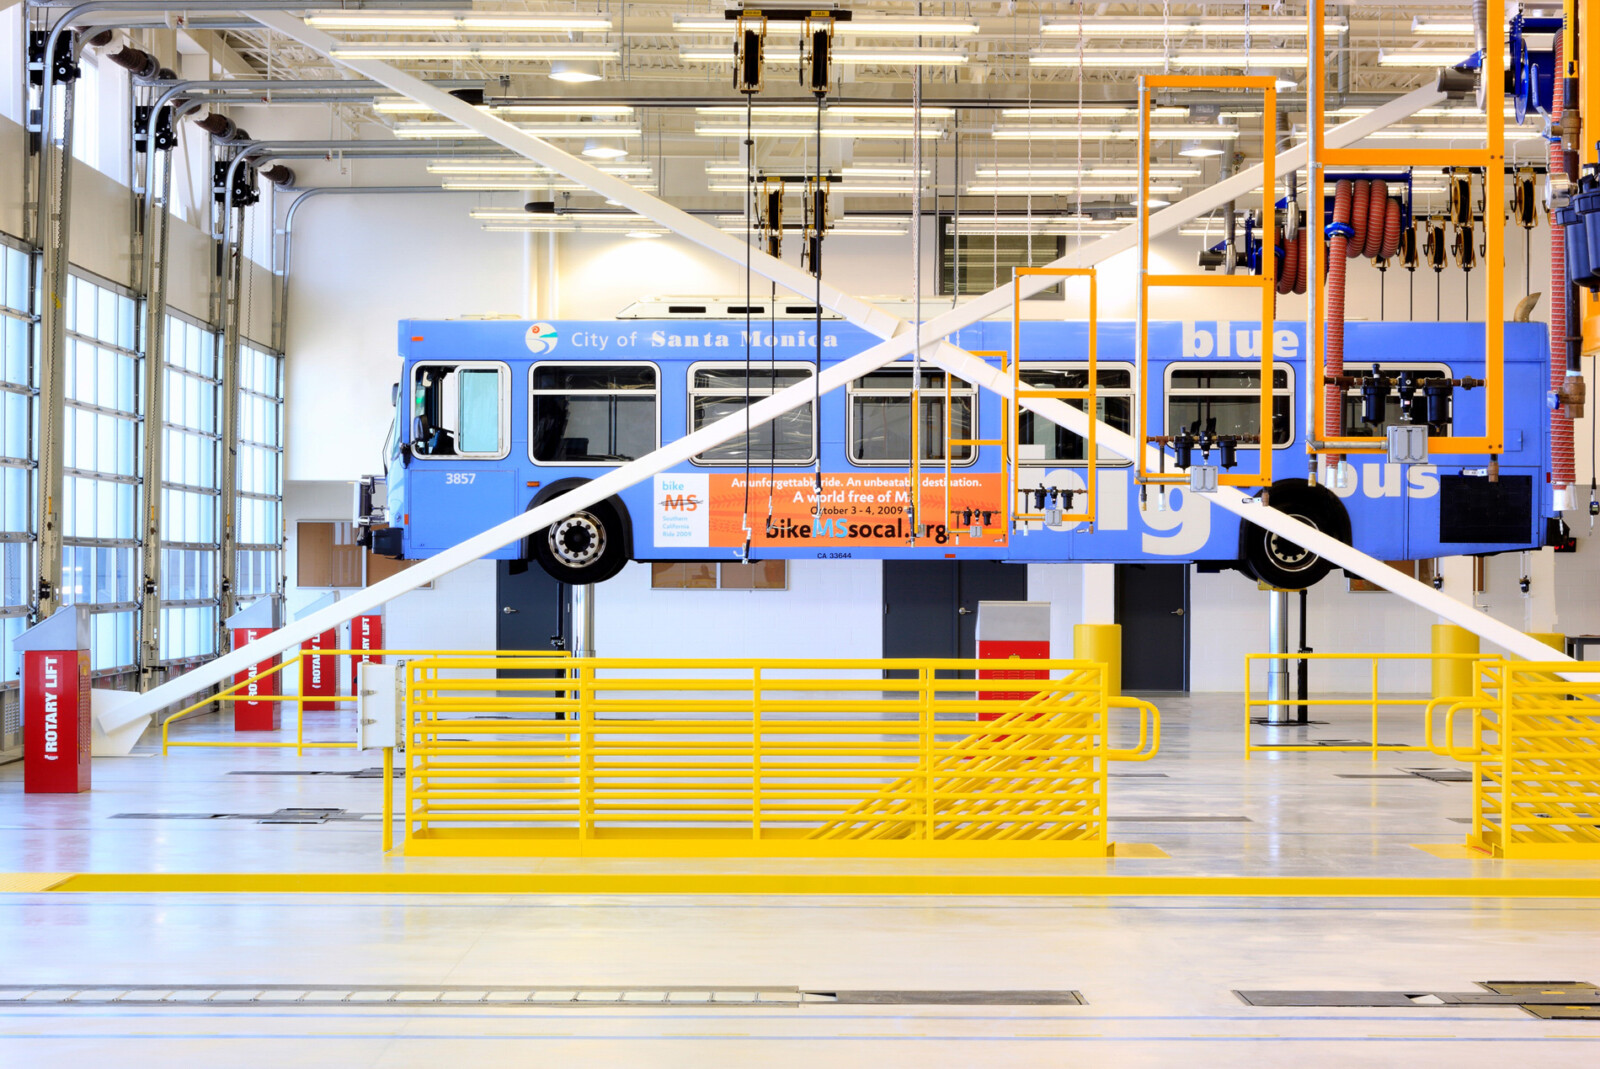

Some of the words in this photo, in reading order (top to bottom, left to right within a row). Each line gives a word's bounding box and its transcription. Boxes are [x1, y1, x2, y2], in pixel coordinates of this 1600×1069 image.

[571, 331, 609, 351] City
[617, 331, 638, 347] of
[651, 330, 729, 348] Santa
[740, 330, 838, 347] Monica
[1182, 321, 1299, 358] blue
[445, 472, 476, 484] 3857
[662, 480, 685, 491] bike
[731, 477, 747, 488] An
[748, 477, 816, 490] unforgettabl
[821, 476, 844, 487] ride.
[846, 477, 861, 487] An
[863, 477, 914, 487] unbeatabl
[664, 494, 698, 512] MS
[792, 491, 804, 503] A
[807, 490, 845, 503] world
[848, 490, 874, 503] free
[877, 490, 892, 503] of
[810, 506, 848, 515] Otober
[851, 506, 857, 515] 3
[865, 506, 875, 515] 4,
[877, 506, 903, 515] 2009
[362, 617, 370, 636] LIFT
[45, 656, 58, 688] LIFT
[45, 692, 58, 753] ROTARY
